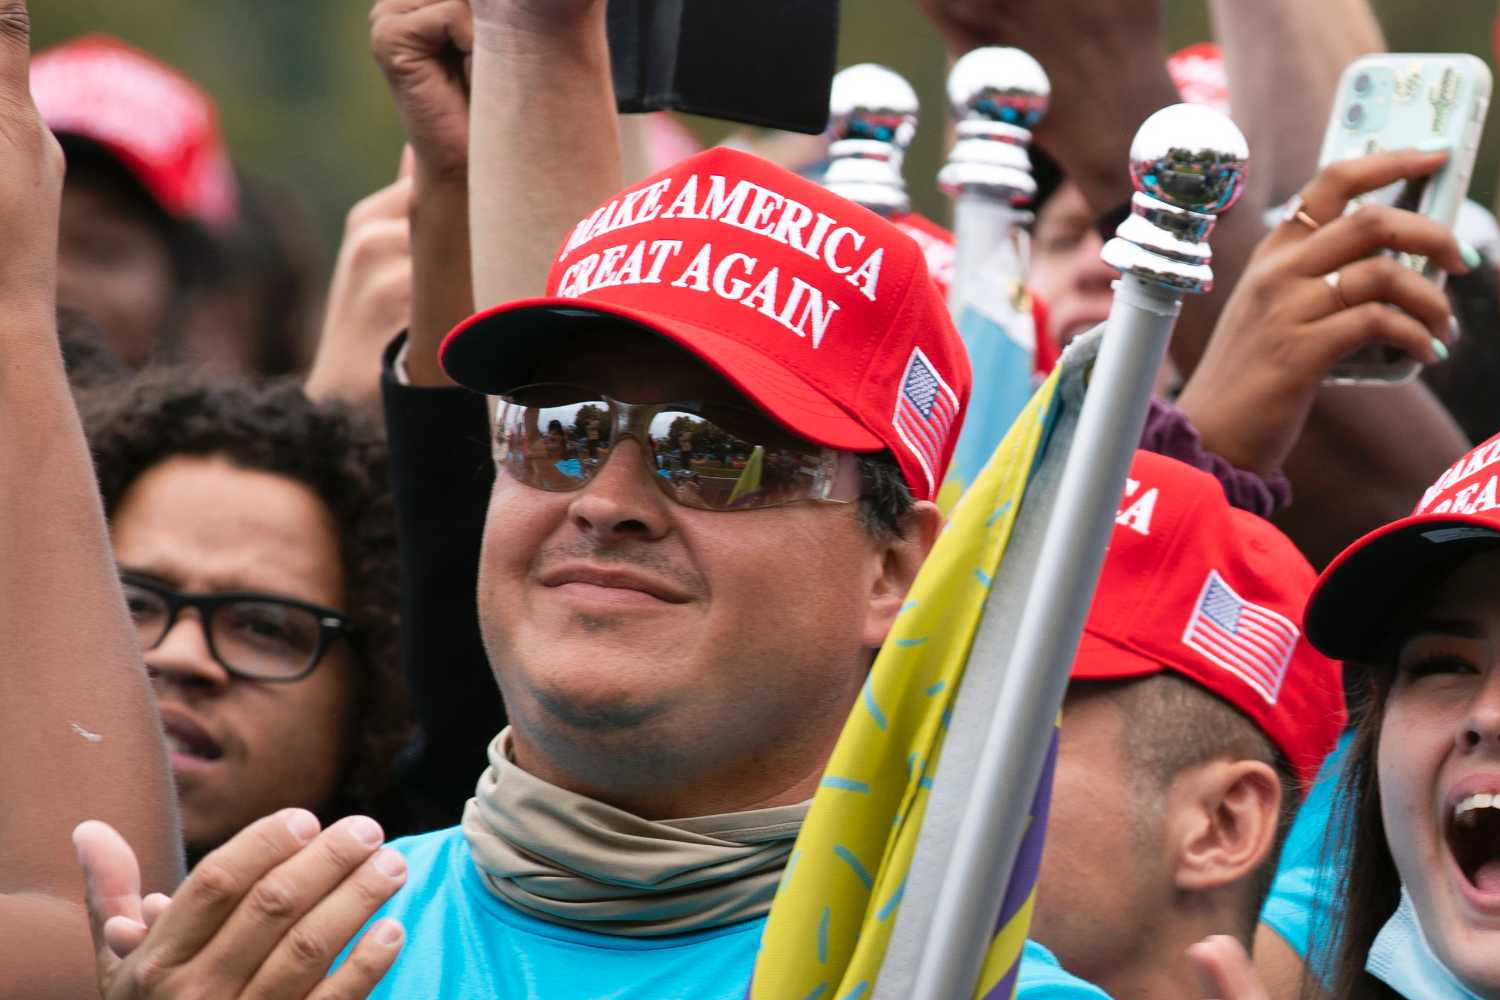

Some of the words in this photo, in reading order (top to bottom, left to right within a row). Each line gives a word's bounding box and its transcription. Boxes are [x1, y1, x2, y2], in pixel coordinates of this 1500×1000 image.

[557, 240, 683, 299] GREAT
[671, 242, 841, 349] AGAIN
[559, 178, 671, 262] MAKE
[661, 174, 884, 301] AMERICA
